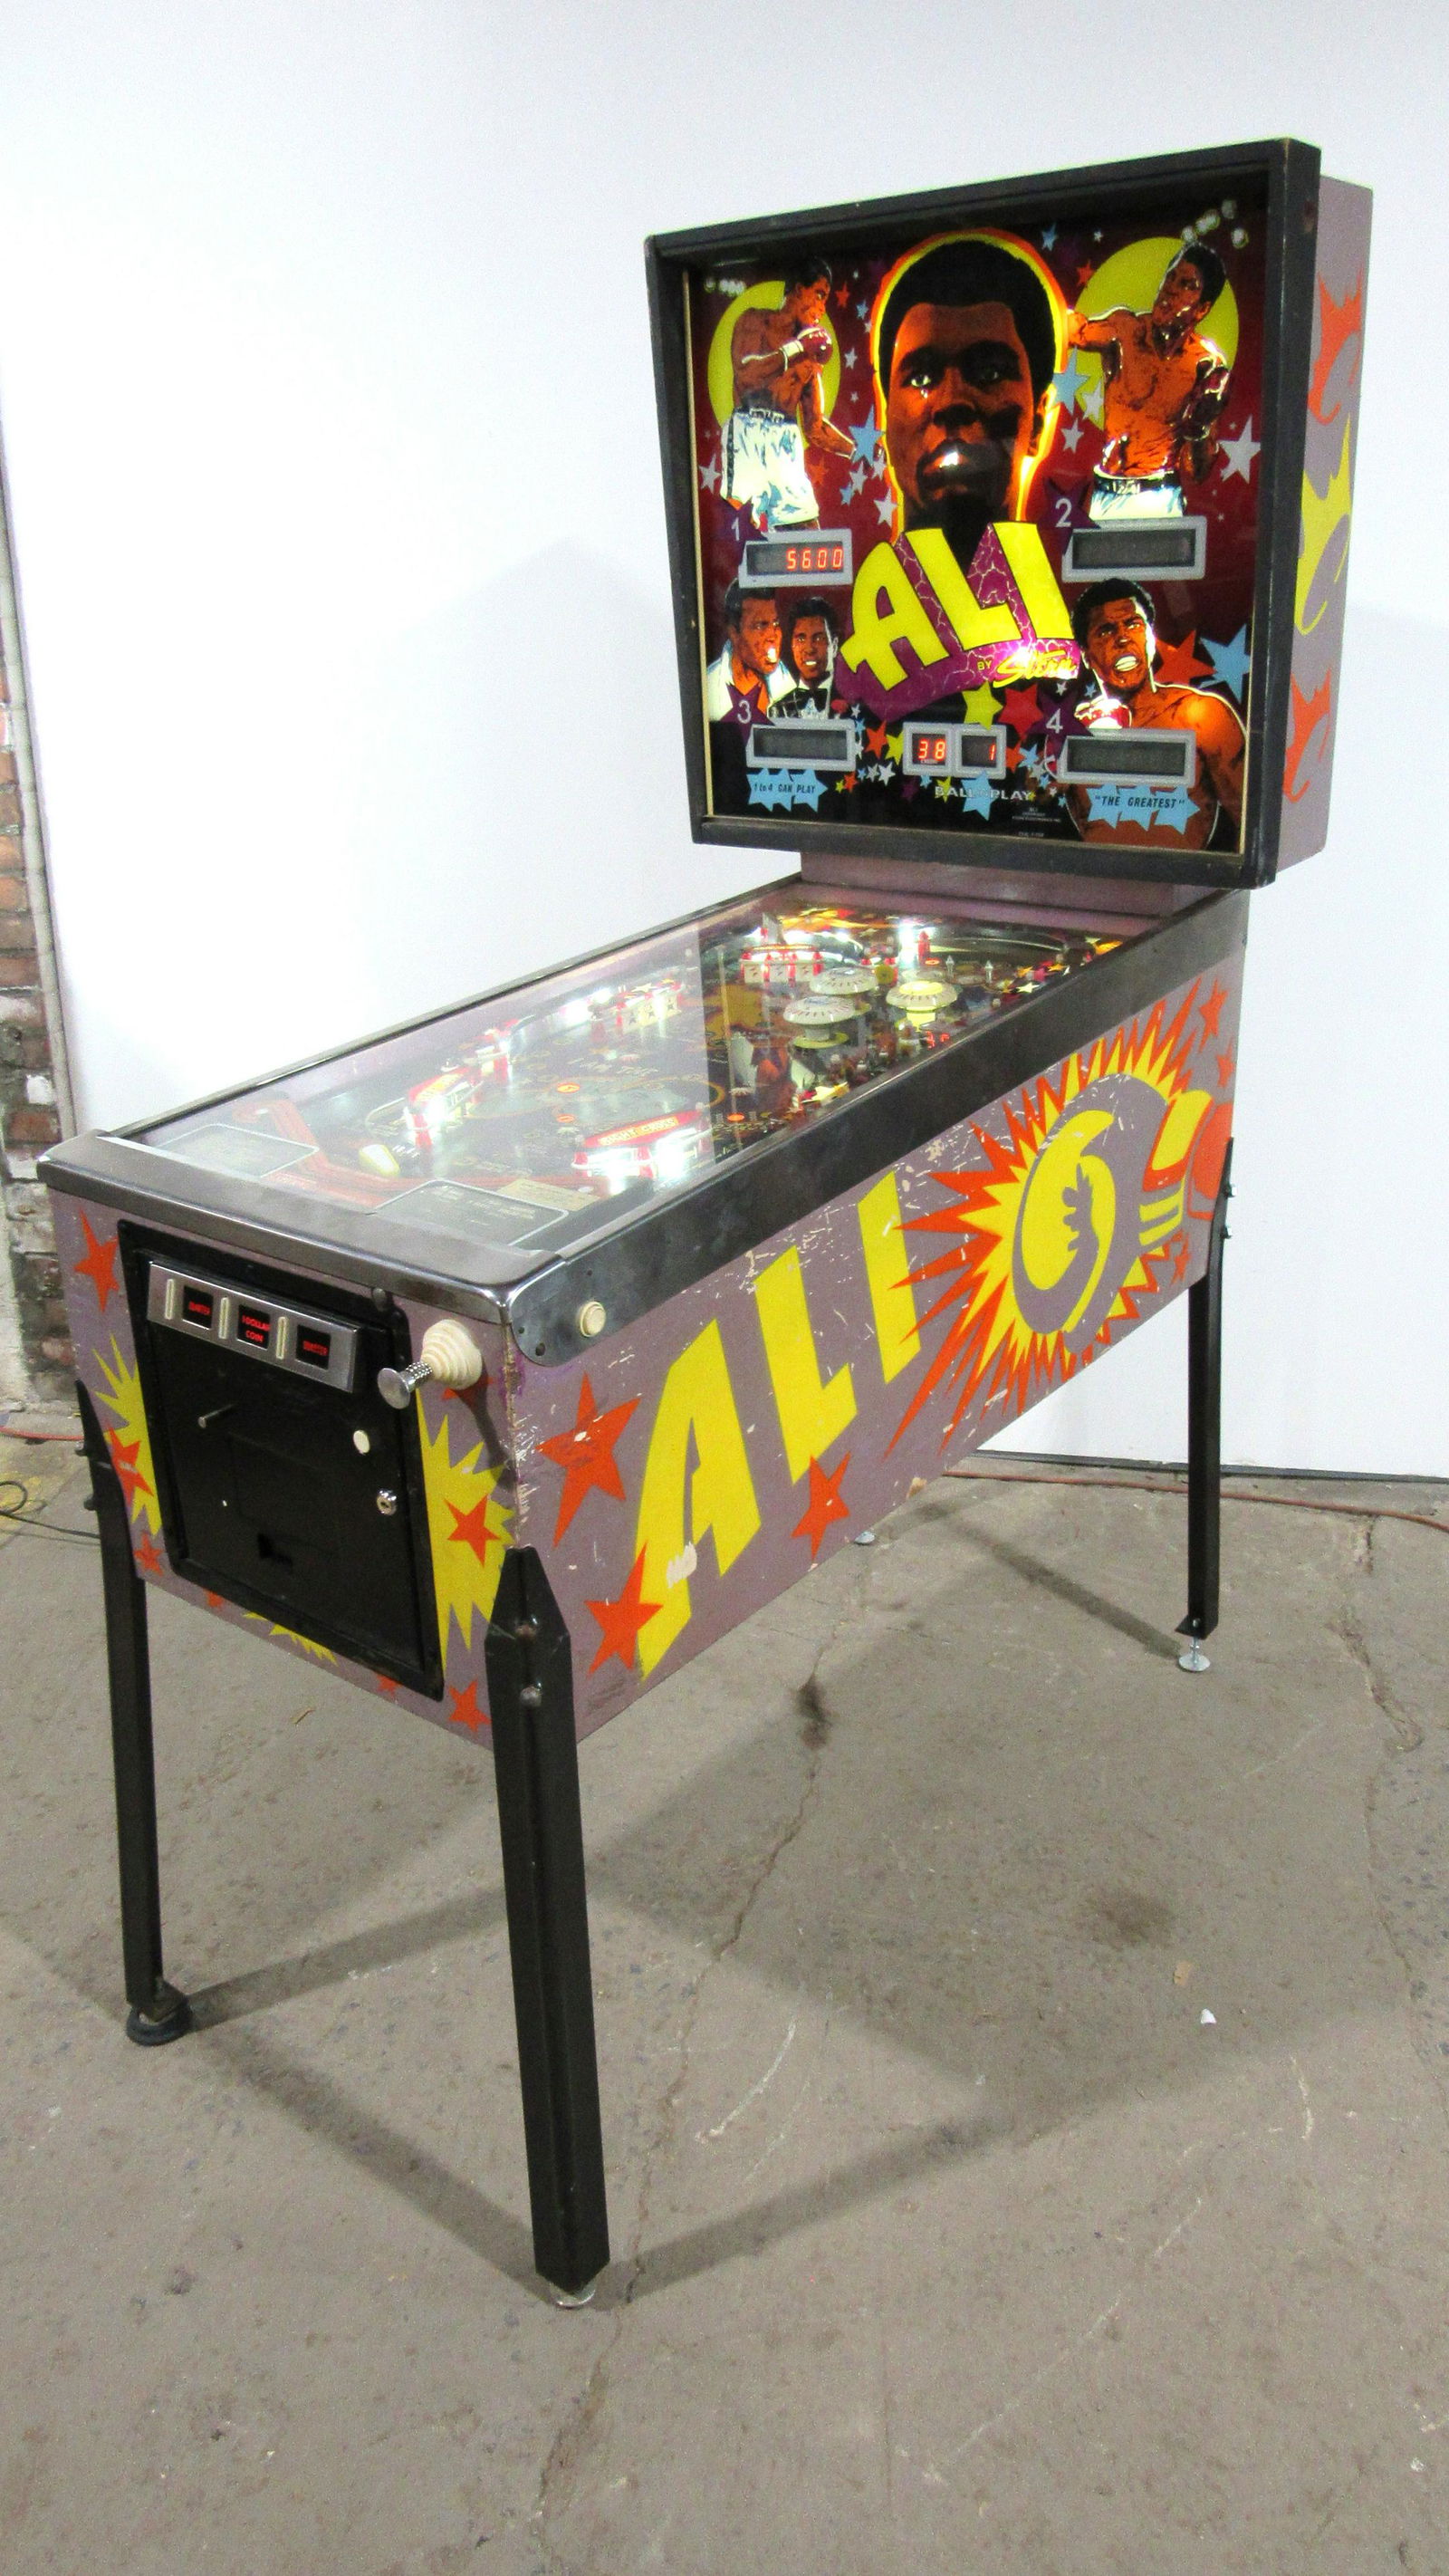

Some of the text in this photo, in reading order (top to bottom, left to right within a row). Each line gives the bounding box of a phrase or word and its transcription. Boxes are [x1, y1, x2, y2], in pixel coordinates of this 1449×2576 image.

[1055, 498, 1072, 527] 2
[731, 517, 740, 542] 1
[785, 547, 844, 572] 5600
[840, 522, 1075, 691] ALI
[977, 660, 993, 670] BY
[737, 699, 752, 725] 3
[1046, 708, 1063, 734] 4
[916, 739, 946, 761] 38
[988, 744, 996, 762] 1
[778, 784, 792, 793] CAN
[796, 784, 816, 794] PLAY
[989, 789, 1032, 801] PLAY
[636, 1170, 921, 1682] ALI
